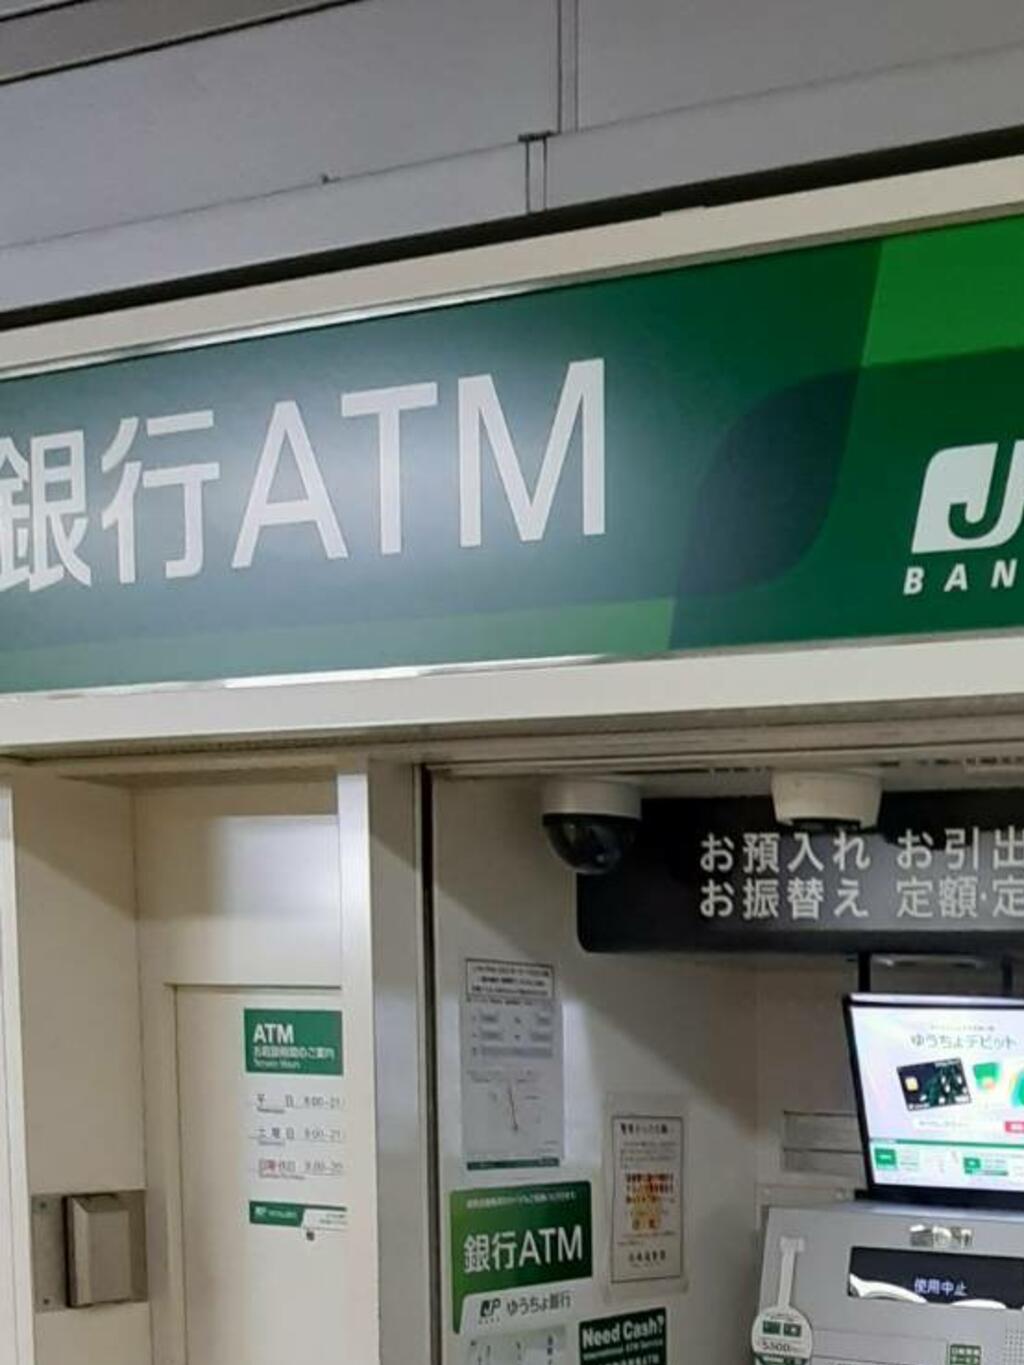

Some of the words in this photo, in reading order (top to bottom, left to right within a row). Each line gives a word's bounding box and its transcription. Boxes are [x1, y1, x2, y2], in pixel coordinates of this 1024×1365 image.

[0, 357, 606, 593] 銀行ATM
[700, 831, 871, 872] お預入れ
[699, 876, 870, 919] お振替え
[253, 1023, 295, 1044] ATM
[910, 1033, 1018, 1050] ゆうちょデビット
[463, 1223, 583, 1275] 銀行ATM
[507, 1291, 572, 1317] ゆうちょ銀行
[914, 1276, 967, 1297] 使用中止
[582, 1322, 621, 1350] Need
[622, 1314, 665, 1341] Cash?
